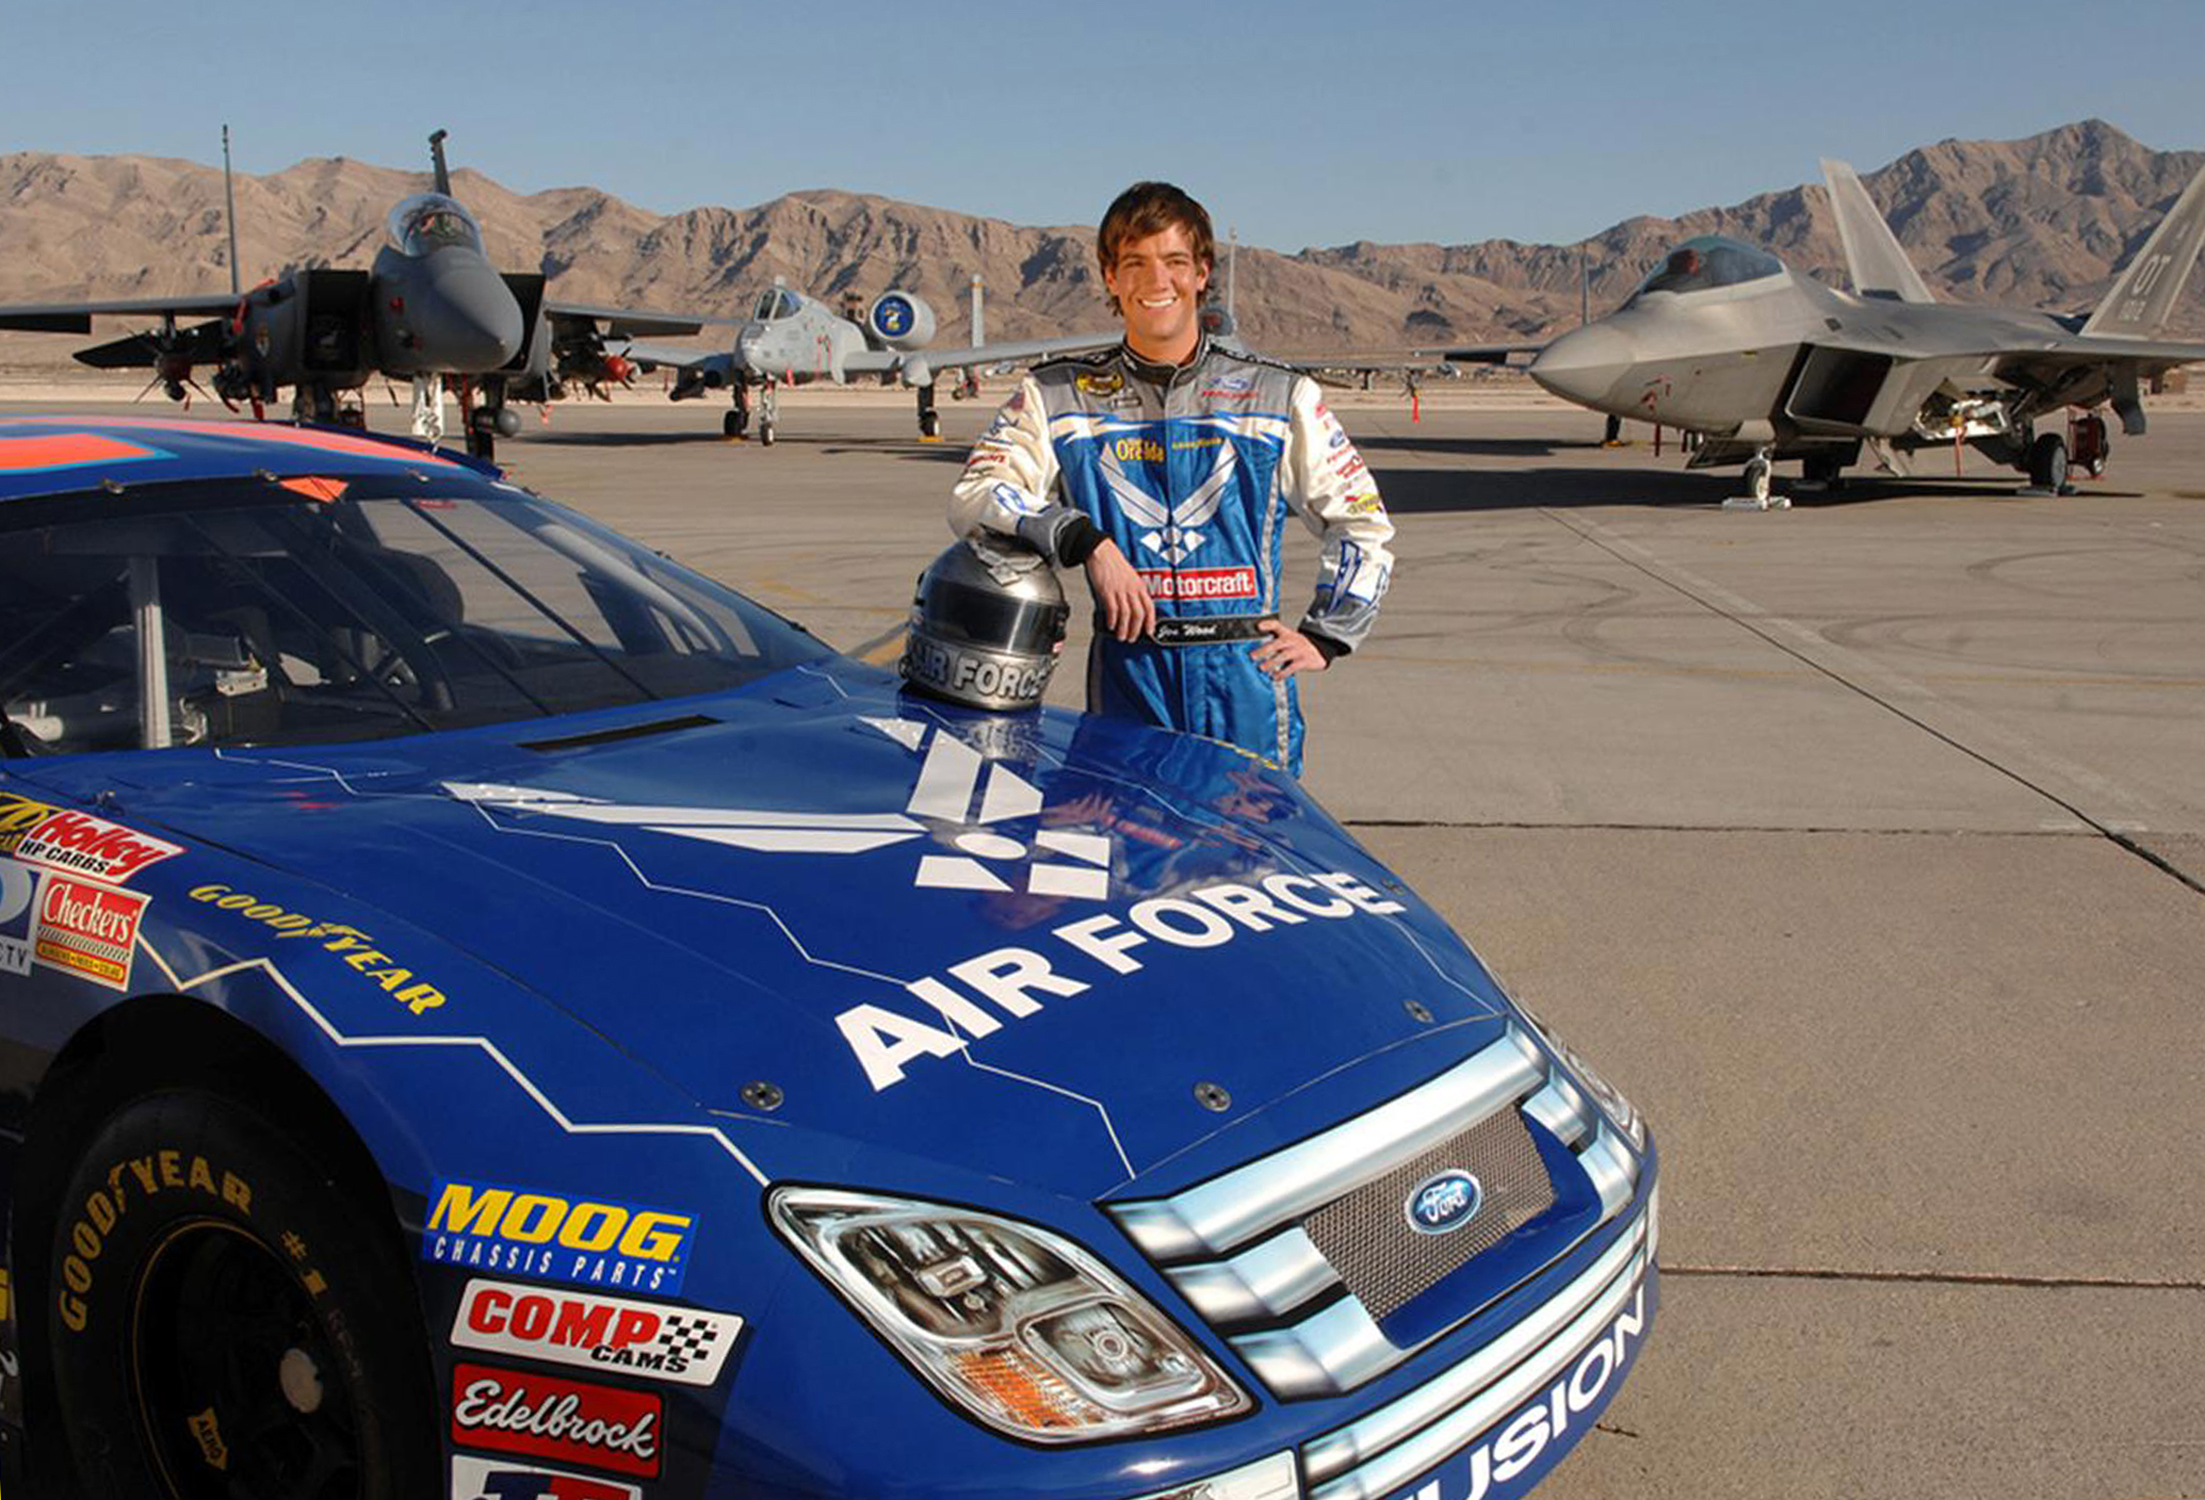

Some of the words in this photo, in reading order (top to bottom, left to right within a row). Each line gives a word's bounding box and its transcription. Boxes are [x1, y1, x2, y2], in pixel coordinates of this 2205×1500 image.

[1142, 572, 1251, 596] Motorcraft
[953, 656, 1047, 698] FORCE
[19, 839, 45, 857] HP
[45, 846, 110, 875] CARBS
[28, 812, 168, 876] Holley
[43, 883, 133, 943] Checkers
[188, 884, 447, 1016] GOODYEAR
[834, 946, 1092, 1092] AIR
[1052, 872, 1406, 975] FORCE
[427, 1183, 691, 1262] MOOG
[1419, 1183, 1468, 1223] Ford
[60, 1150, 252, 1332] GOODYEAR
[434, 1236, 552, 1274] CHASSIS
[467, 1289, 661, 1349] COMP
[591, 1345, 688, 1373] CAMS
[454, 1379, 656, 1457] Edelbrock
[1402, 1285, 1643, 1500] USION
